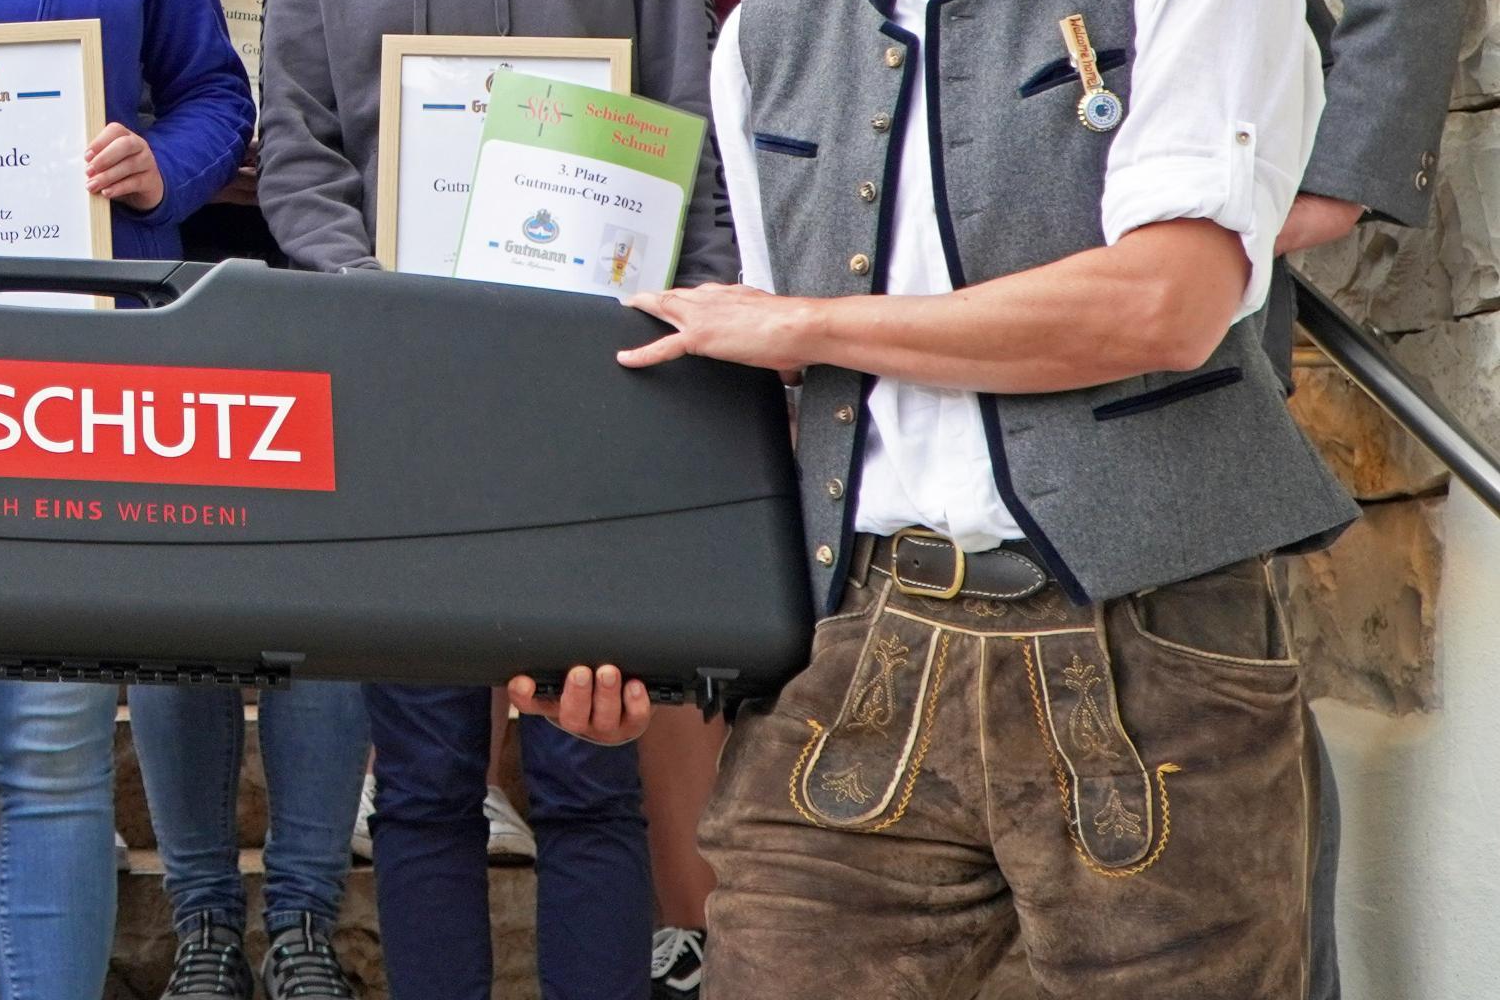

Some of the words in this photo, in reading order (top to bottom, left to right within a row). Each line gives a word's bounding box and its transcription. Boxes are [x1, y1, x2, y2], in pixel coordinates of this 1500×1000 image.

[585, 103, 671, 139] Schießsport
[611, 130, 667, 159] Schmid
[558, 163, 570, 178] 3.
[574, 166, 608, 186] Platz
[513, 173, 610, 205] Gutmann-Cup
[613, 194, 644, 214] 2022
[23, 225, 60, 240] 2022
[504, 240, 567, 265] Gutmann
[34, 498, 104, 522] EINS
[119, 501, 249, 528] WERDEN!
